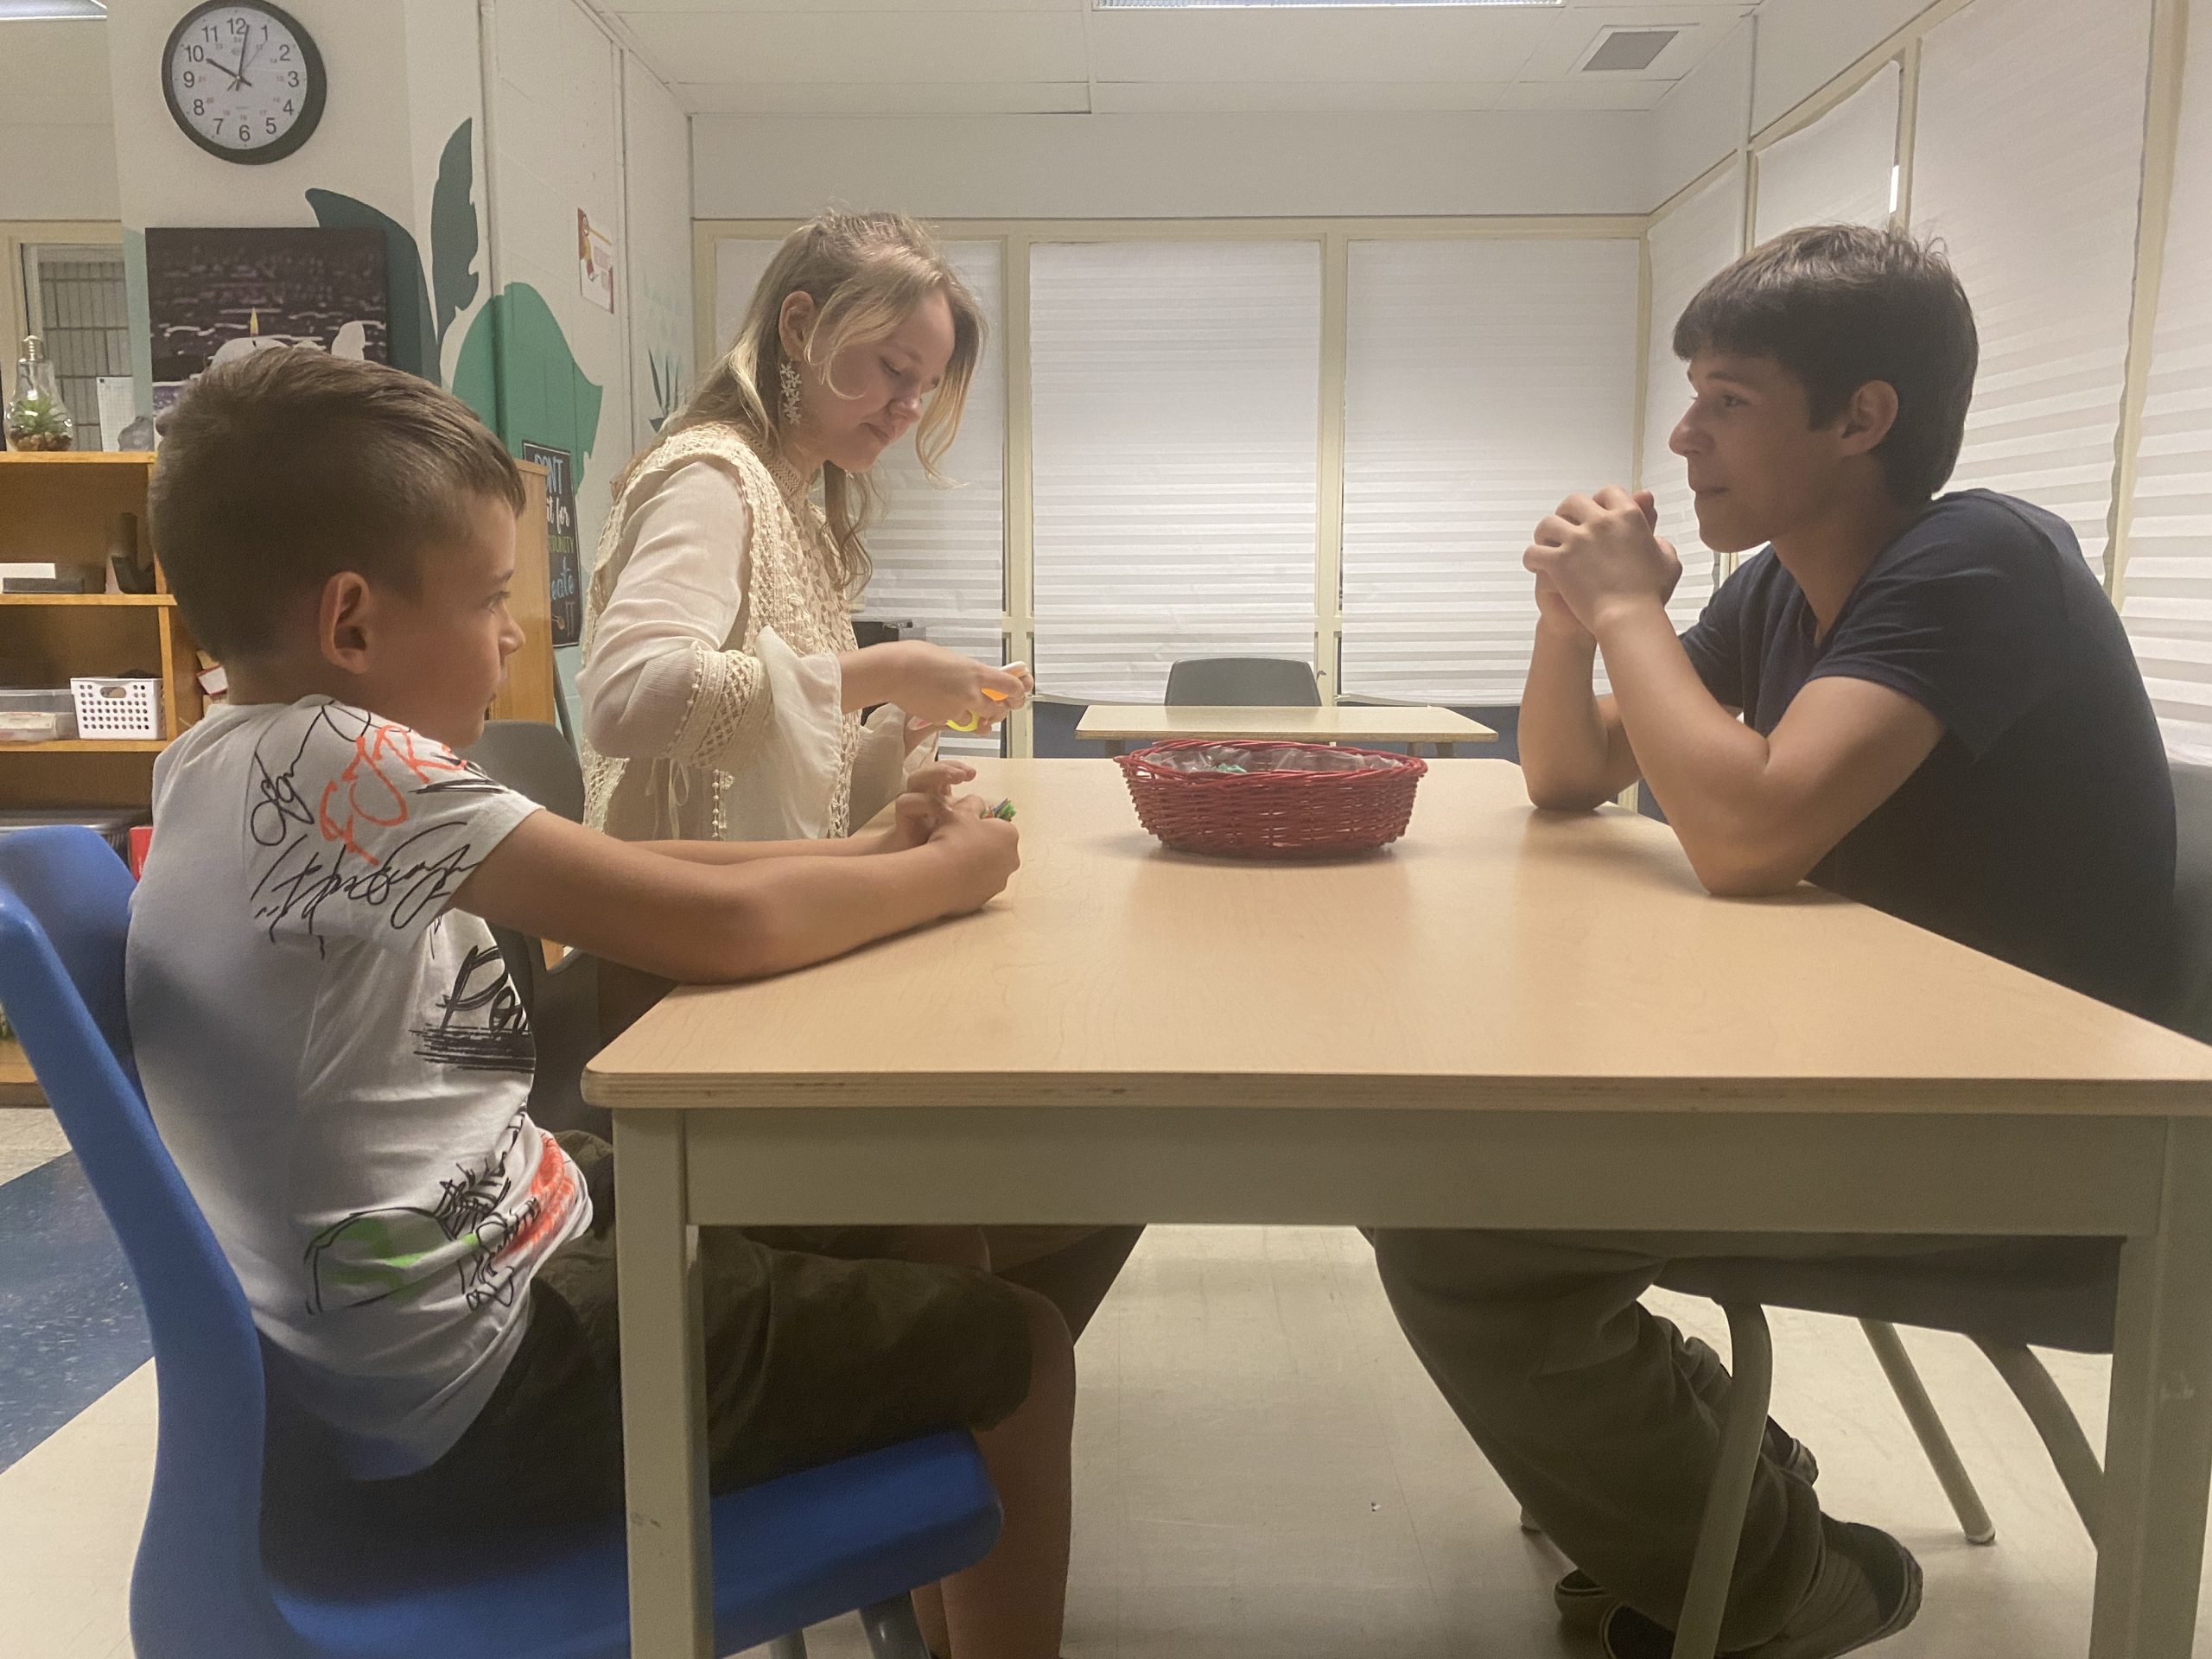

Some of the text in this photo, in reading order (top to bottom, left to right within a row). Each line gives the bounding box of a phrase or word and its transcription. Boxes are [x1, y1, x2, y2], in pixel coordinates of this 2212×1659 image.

[201, 25, 219, 43] 11
[226, 17, 247, 35] 12
[261, 24, 269, 41] 1
[184, 45, 204, 63] 10
[278, 44, 291, 61] 2
[182, 71, 195, 88] 9
[287, 71, 300, 88] 3
[193, 99, 205, 117] 8
[282, 99, 295, 117] 4
[213, 118, 225, 135] 7
[238, 124, 251, 143] 6
[265, 118, 277, 135] 5
[550, 556, 575, 601] eate
